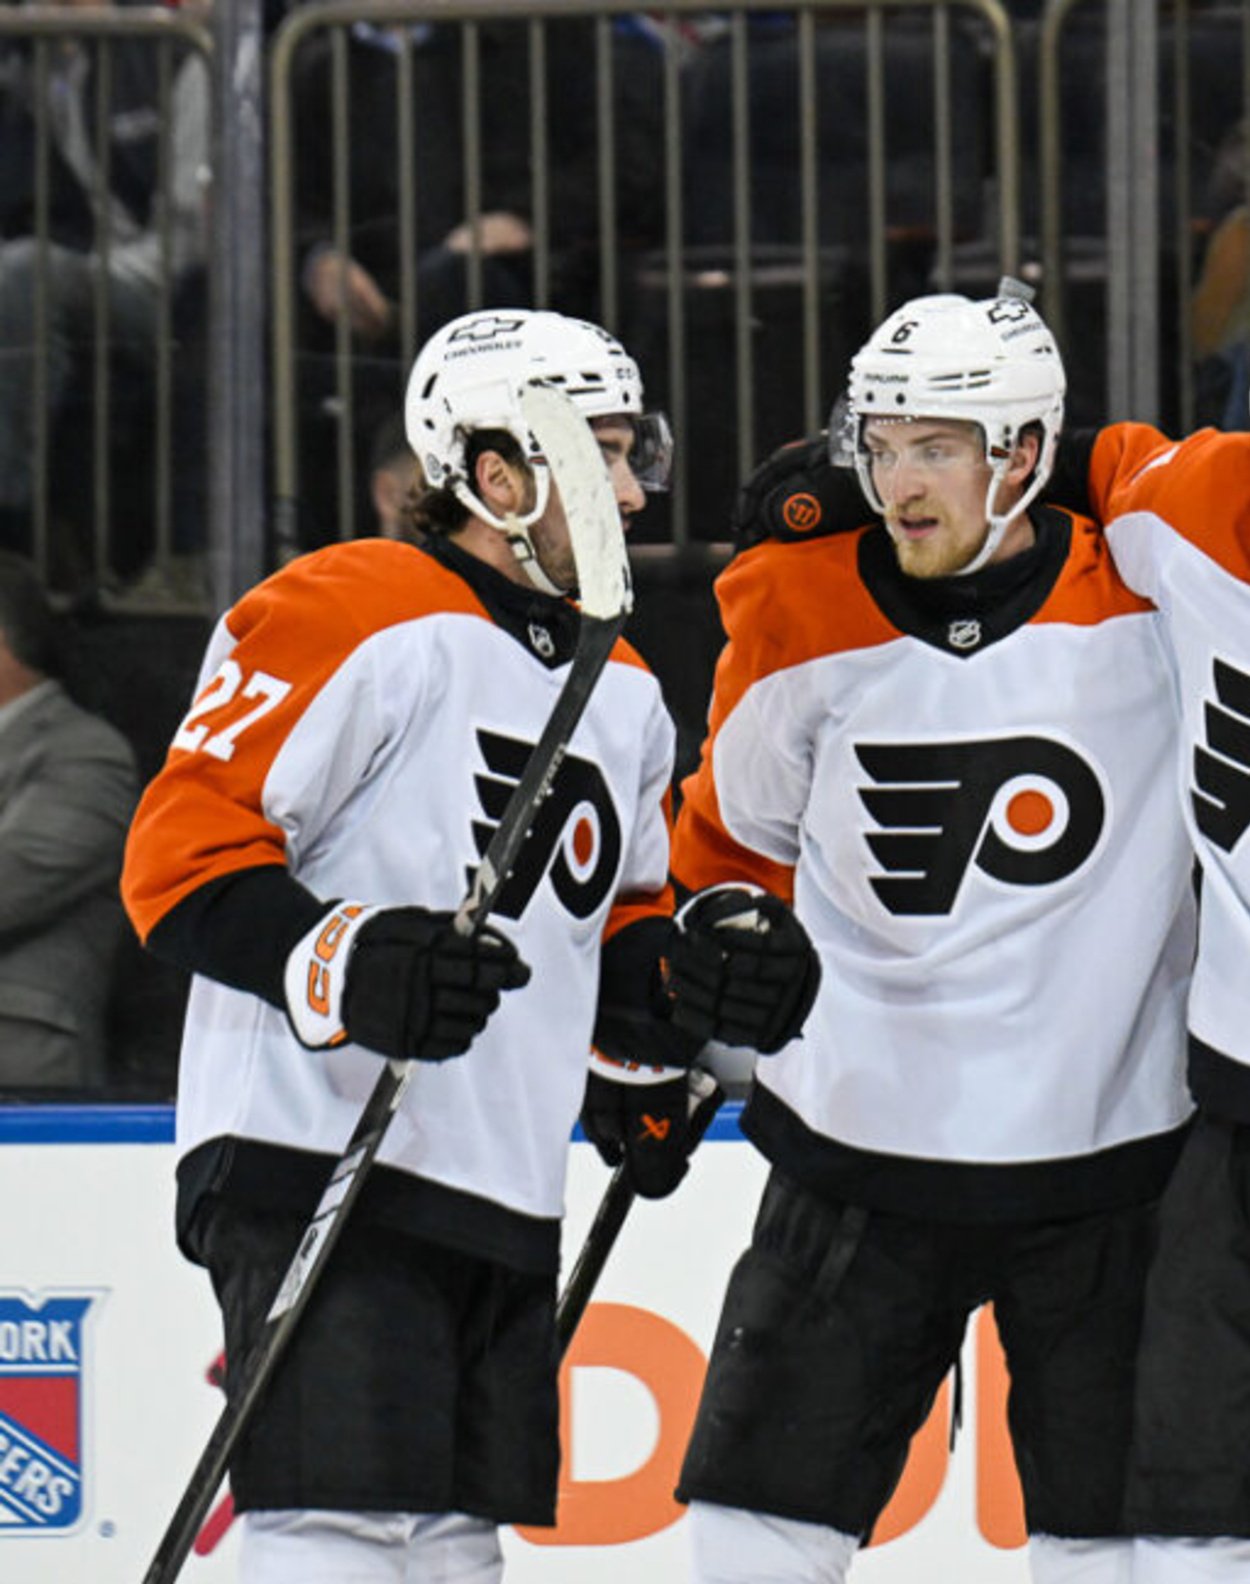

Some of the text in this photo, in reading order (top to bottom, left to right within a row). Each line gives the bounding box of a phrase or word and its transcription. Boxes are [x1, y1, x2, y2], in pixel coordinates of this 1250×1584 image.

[891, 321, 918, 344] 6
[171, 659, 294, 763] 27
[307, 905, 364, 1018] CC
[0, 1320, 79, 1361] ORK
[0, 1434, 74, 1516] ERS
